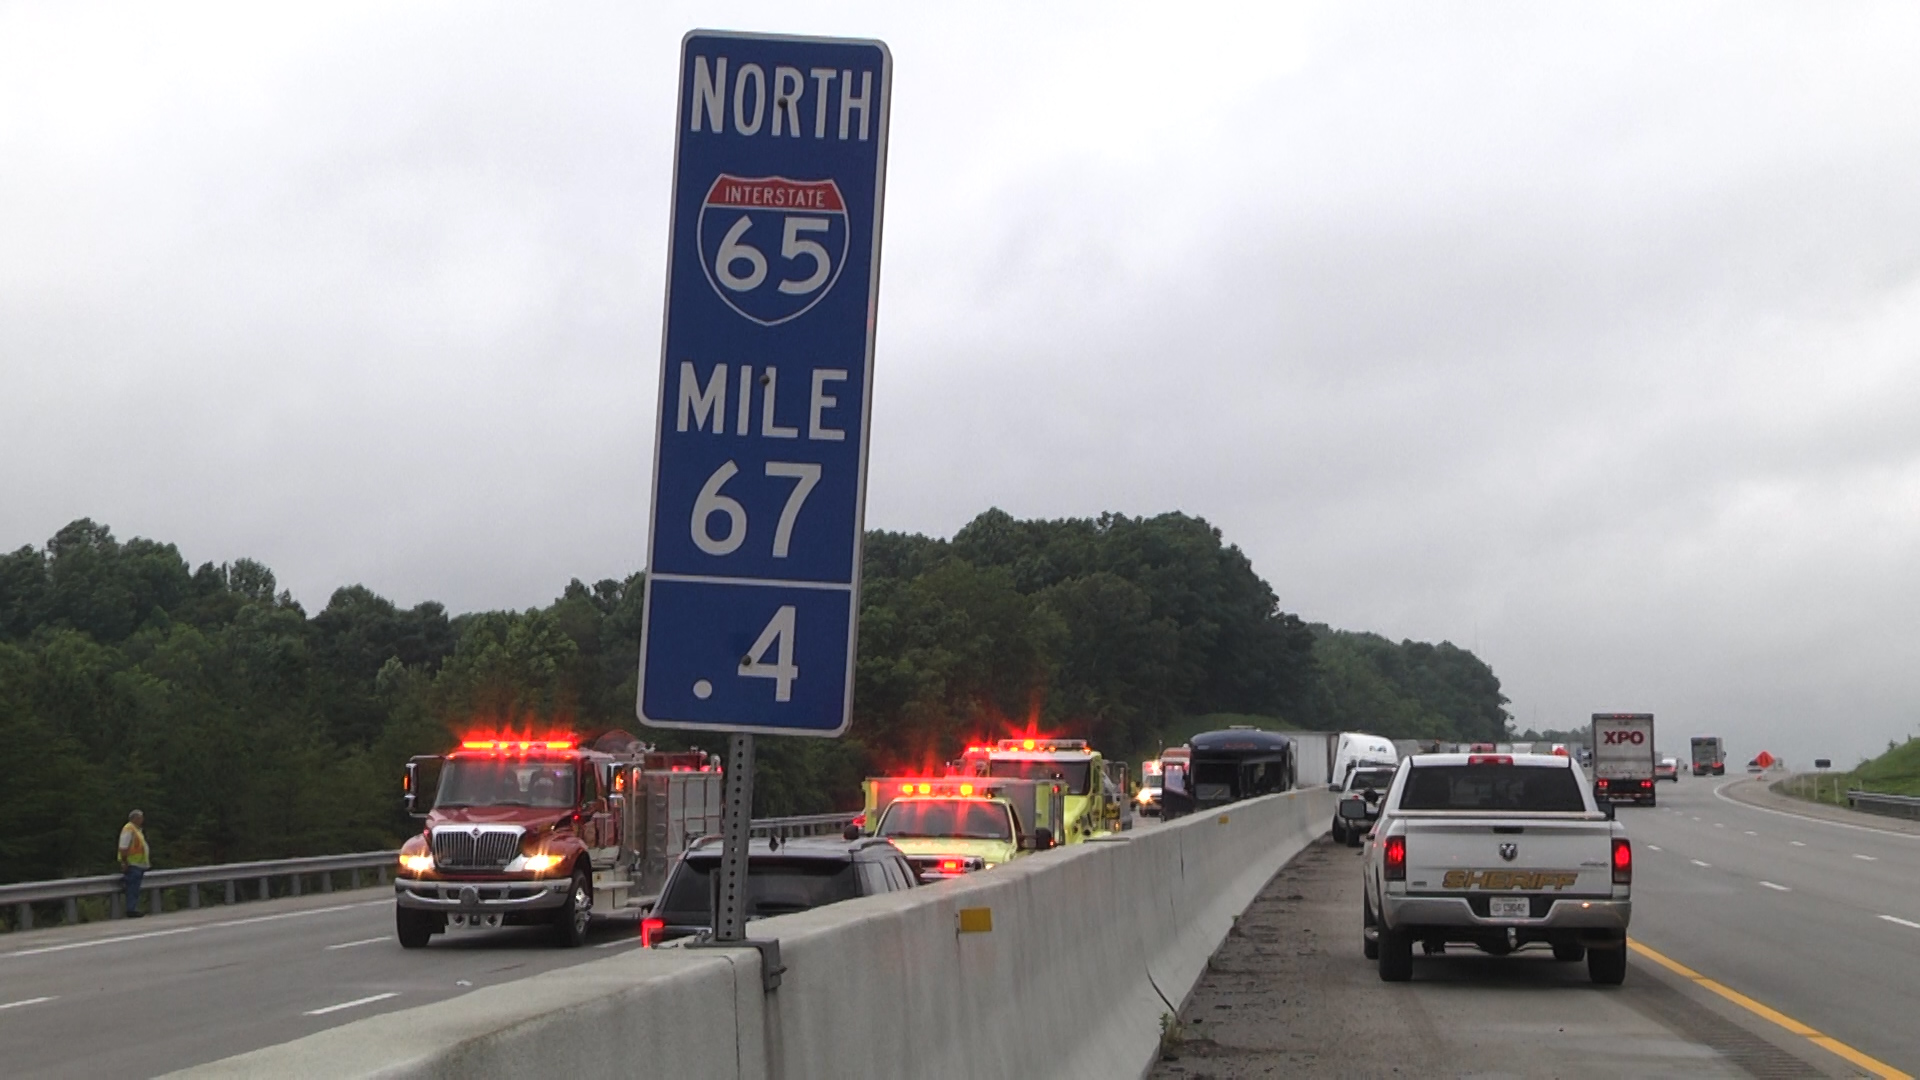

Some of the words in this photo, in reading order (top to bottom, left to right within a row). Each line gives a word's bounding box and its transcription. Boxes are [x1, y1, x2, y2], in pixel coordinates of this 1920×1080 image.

[691, 55, 872, 141] NORTH
[725, 185, 825, 208] INTERSTATE
[715, 215, 831, 294] 65
[677, 361, 848, 440] MILE
[690, 459, 822, 558] 67
[1603, 731, 1644, 745] XPO
[1442, 871, 1578, 890] SHERIFF
